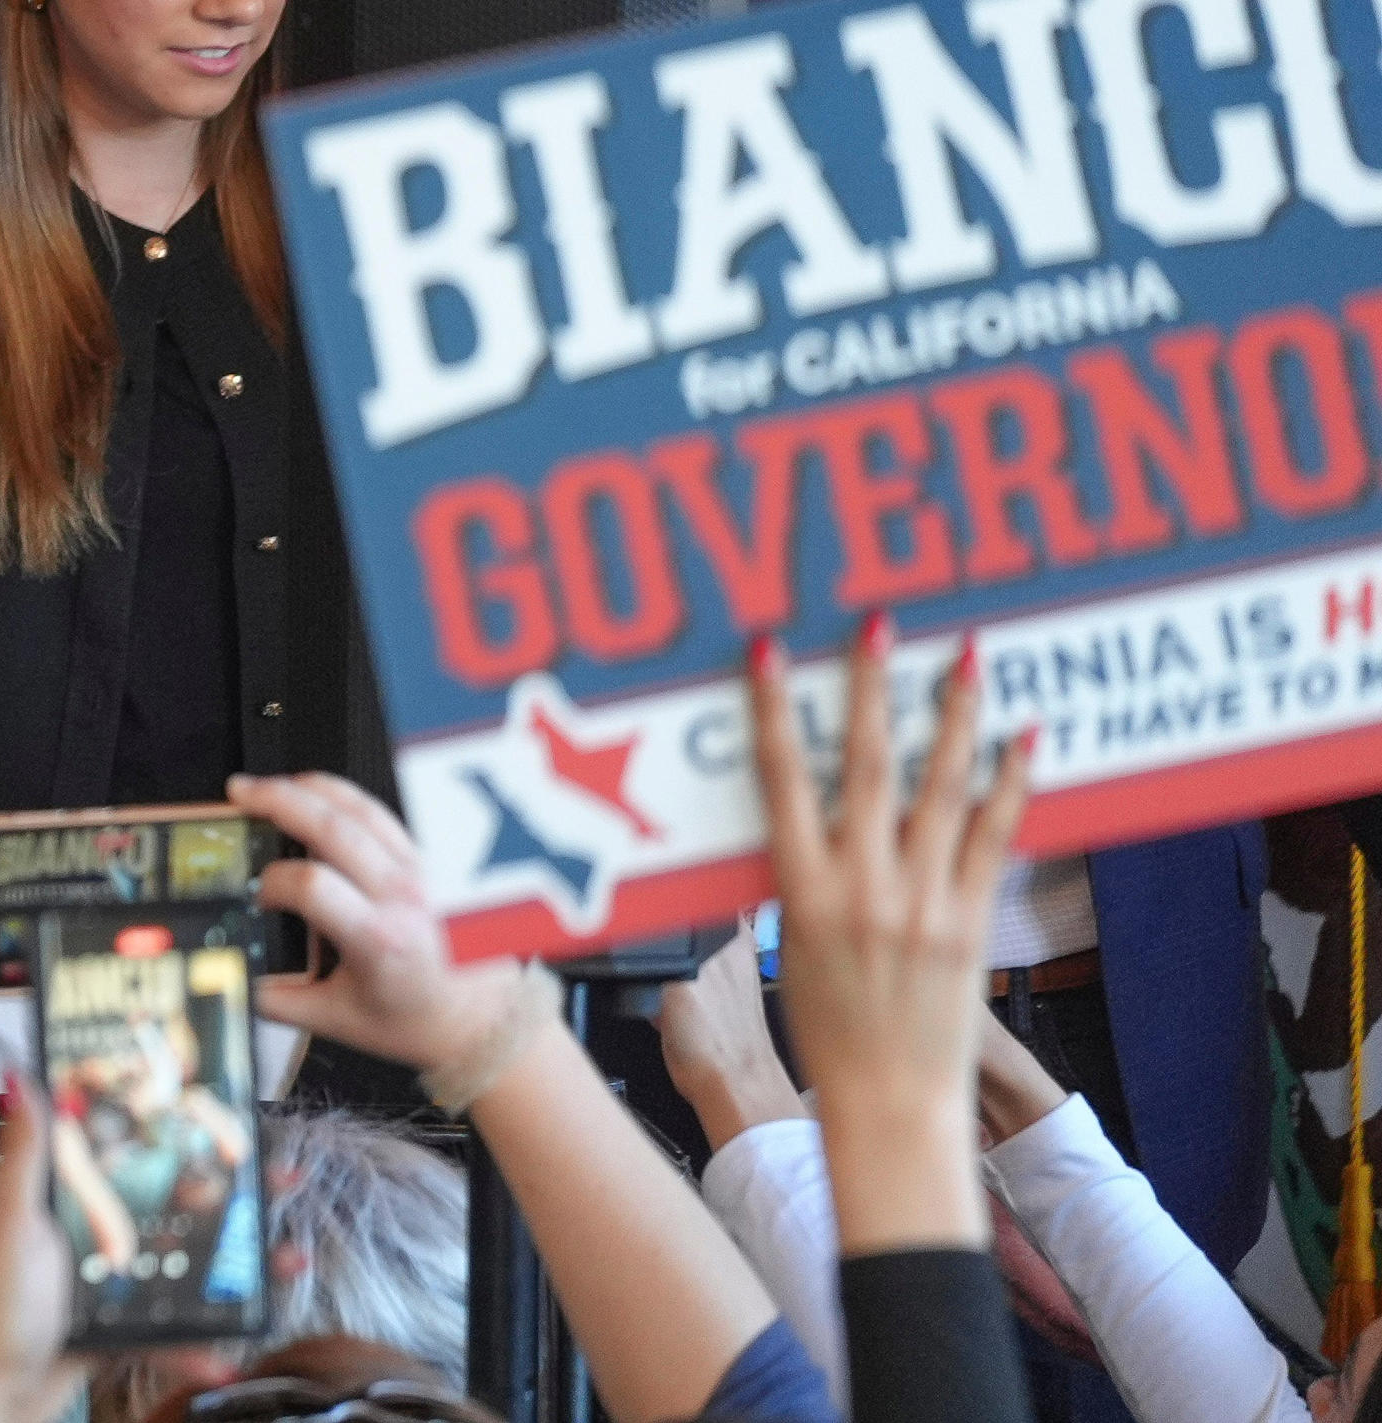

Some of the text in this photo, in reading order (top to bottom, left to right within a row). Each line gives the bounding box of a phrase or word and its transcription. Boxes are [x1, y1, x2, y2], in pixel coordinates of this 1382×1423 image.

[680, 258, 1181, 416] for CALIFORNIA
[413, 294, 1382, 686] GOVERNO
[1219, 593, 1297, 661] IS
[1097, 679, 1238, 754] HAVE
[1264, 660, 1338, 714] TO
